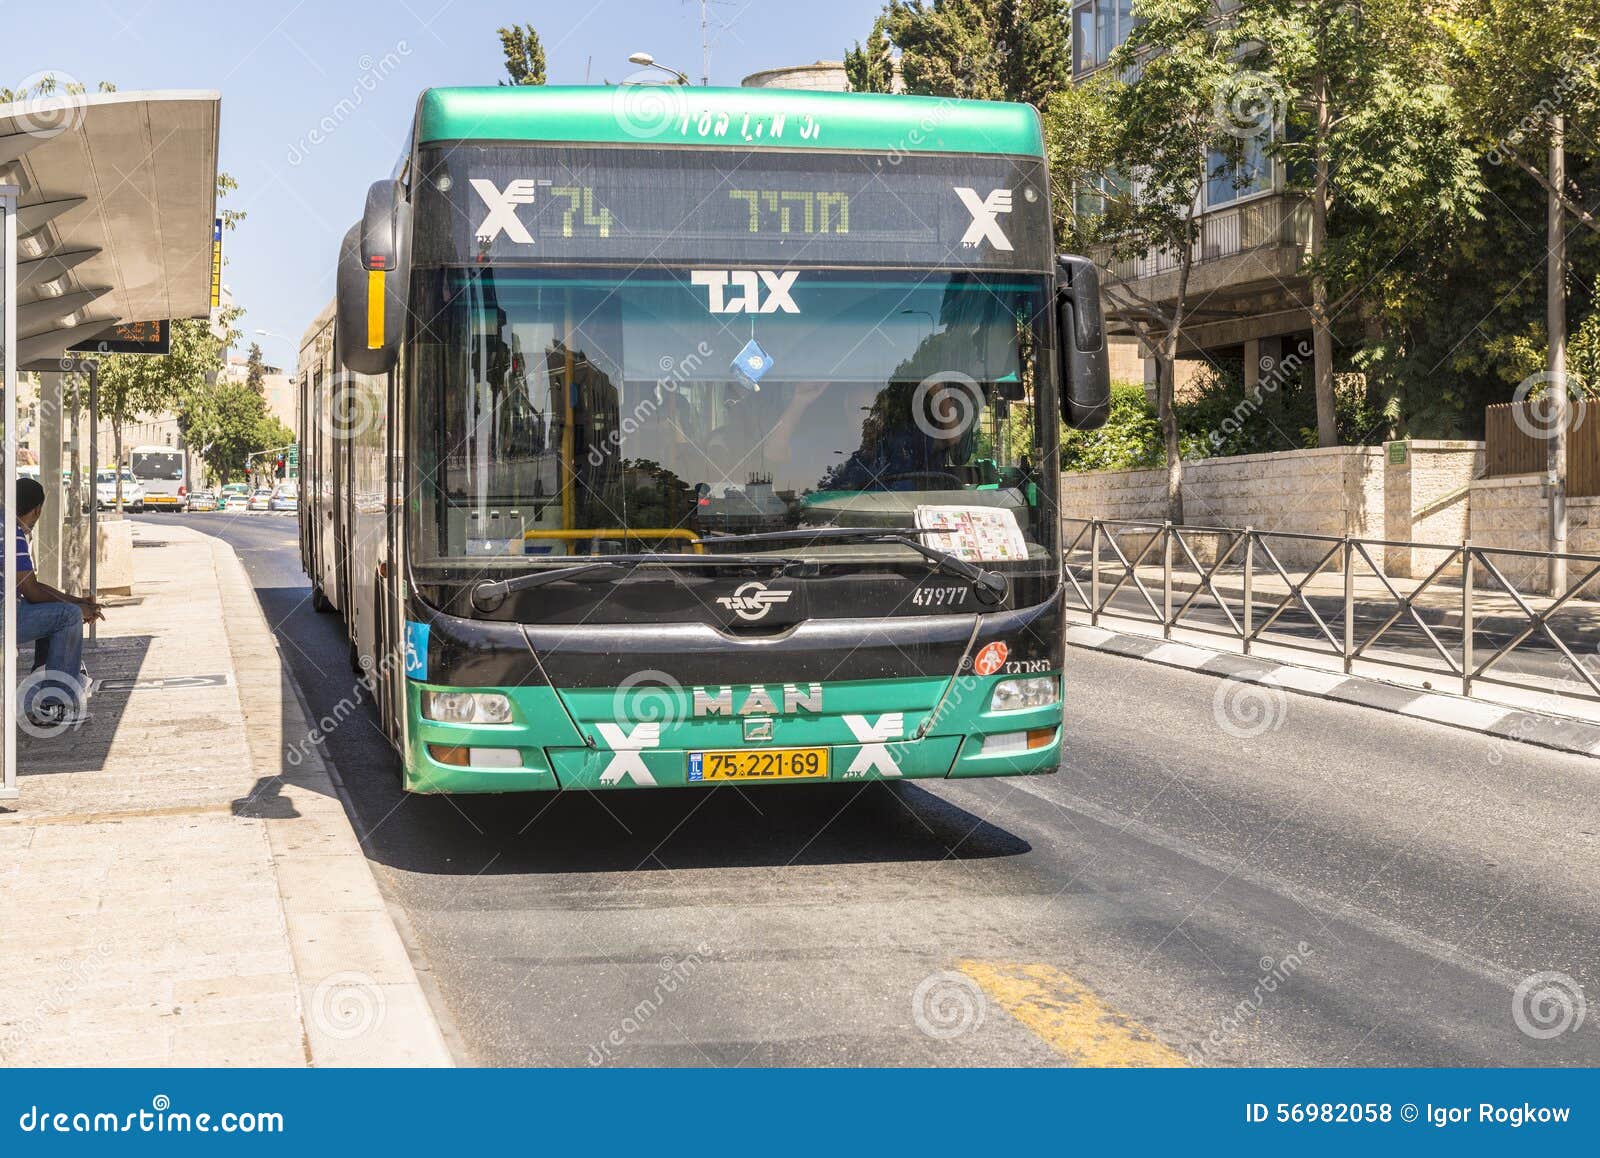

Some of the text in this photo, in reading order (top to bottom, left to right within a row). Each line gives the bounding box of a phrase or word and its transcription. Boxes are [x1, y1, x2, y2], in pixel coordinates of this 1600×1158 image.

[550, 186, 613, 237] 74
[729, 190, 849, 233] מהיר
[691, 270, 800, 313] אגד
[912, 586, 968, 606] 47977
[1005, 659, 1051, 674] הארגז
[692, 682, 823, 717] MAN
